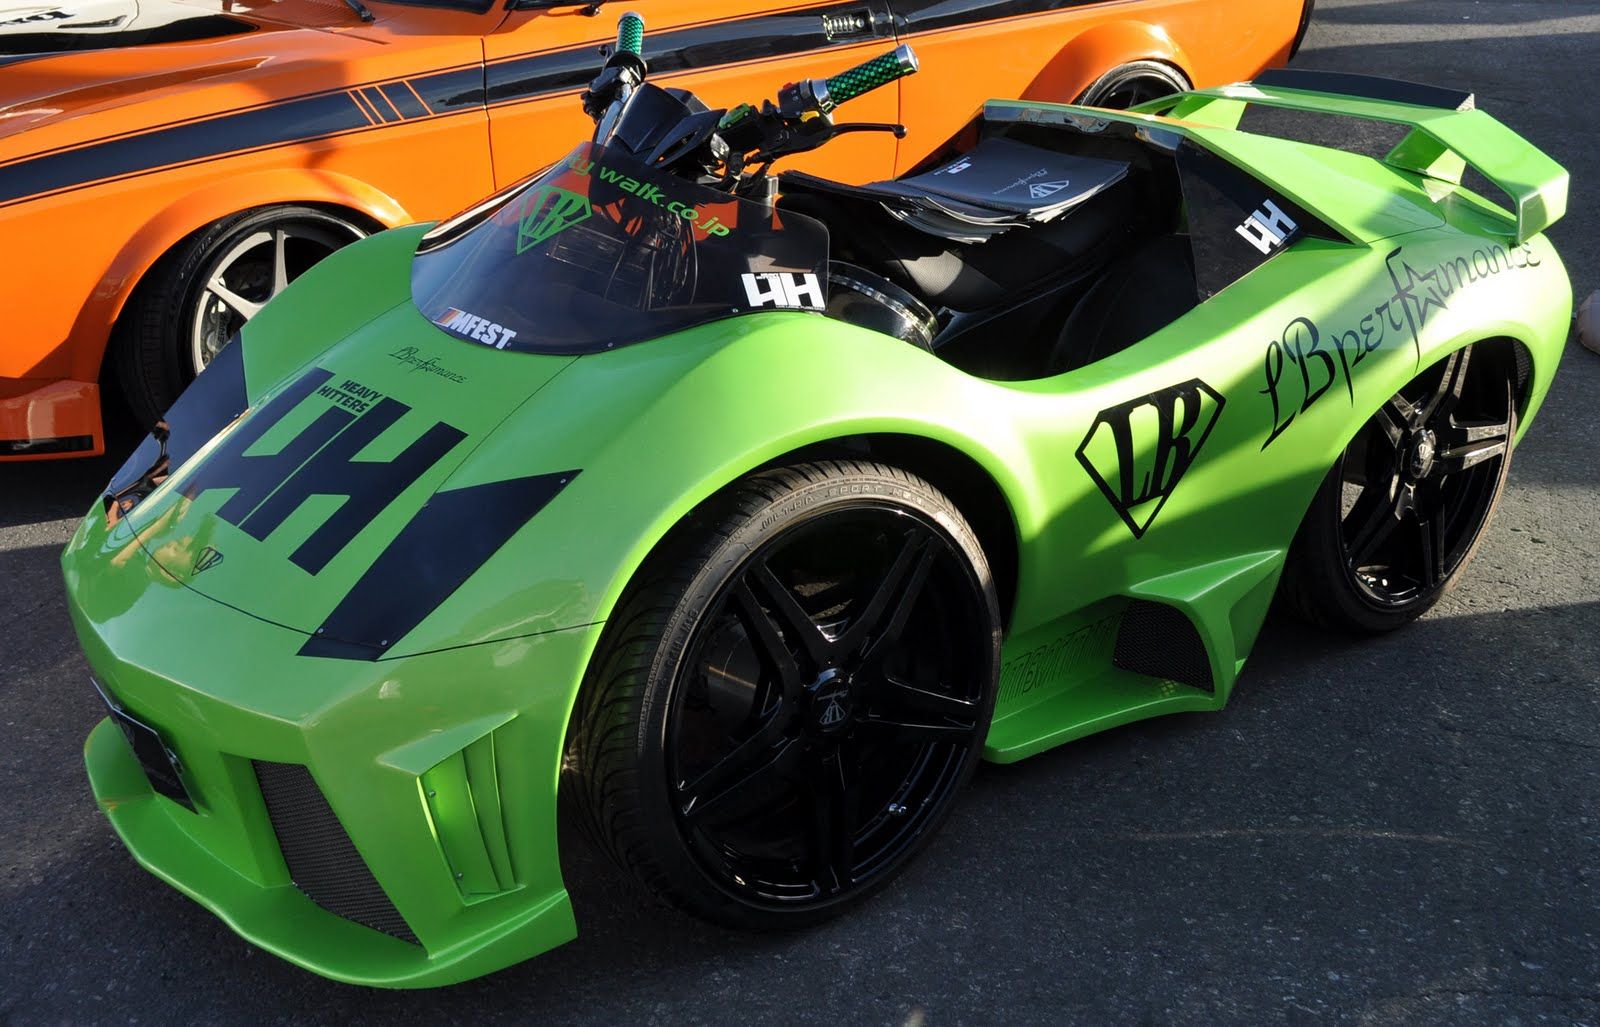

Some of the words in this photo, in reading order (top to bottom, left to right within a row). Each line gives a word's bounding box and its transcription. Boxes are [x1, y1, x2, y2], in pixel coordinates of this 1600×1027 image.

[599, 166, 730, 238] walk.co.jp
[444, 309, 518, 349] MFEST
[317, 385, 371, 413] HITTERS
[340, 379, 383, 401] HEAVY
